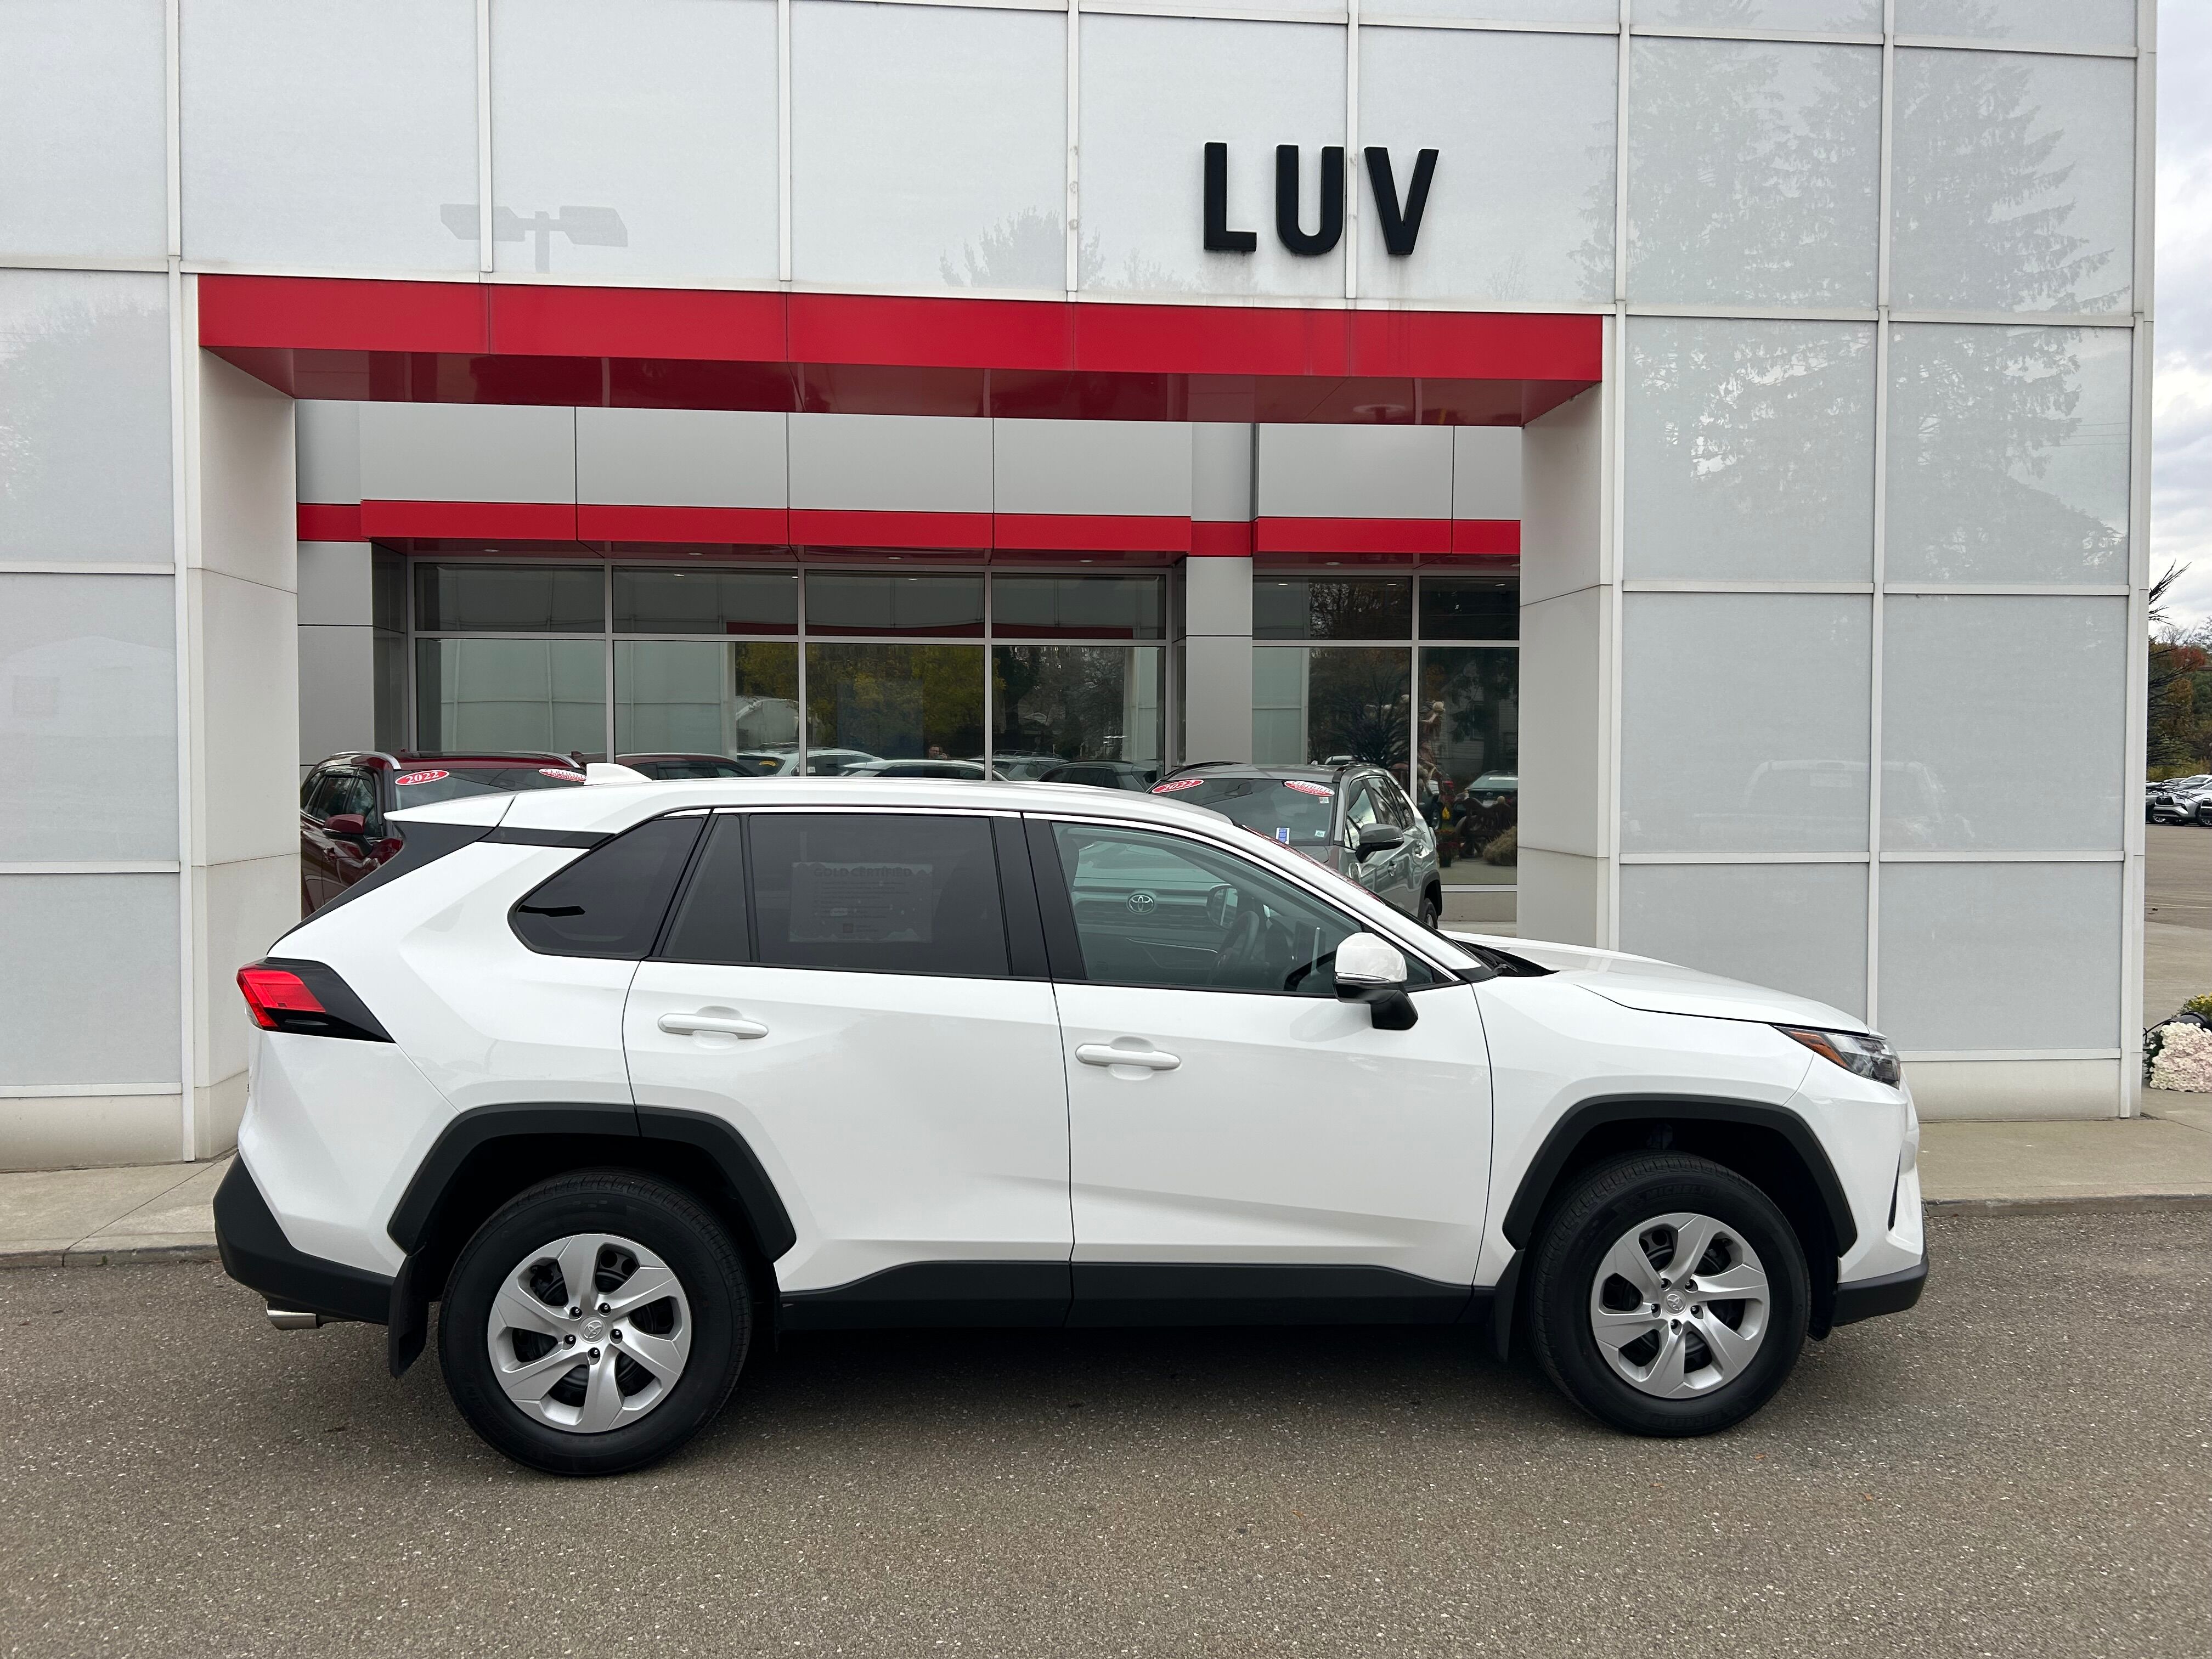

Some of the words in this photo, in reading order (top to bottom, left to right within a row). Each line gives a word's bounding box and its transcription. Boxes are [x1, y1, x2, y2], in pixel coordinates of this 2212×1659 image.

[1204, 142, 1439, 255] LUV
[405, 771, 439, 784] 2022
[1159, 780, 1195, 792] 2022
[851, 868, 912, 877] CERTIFIED
